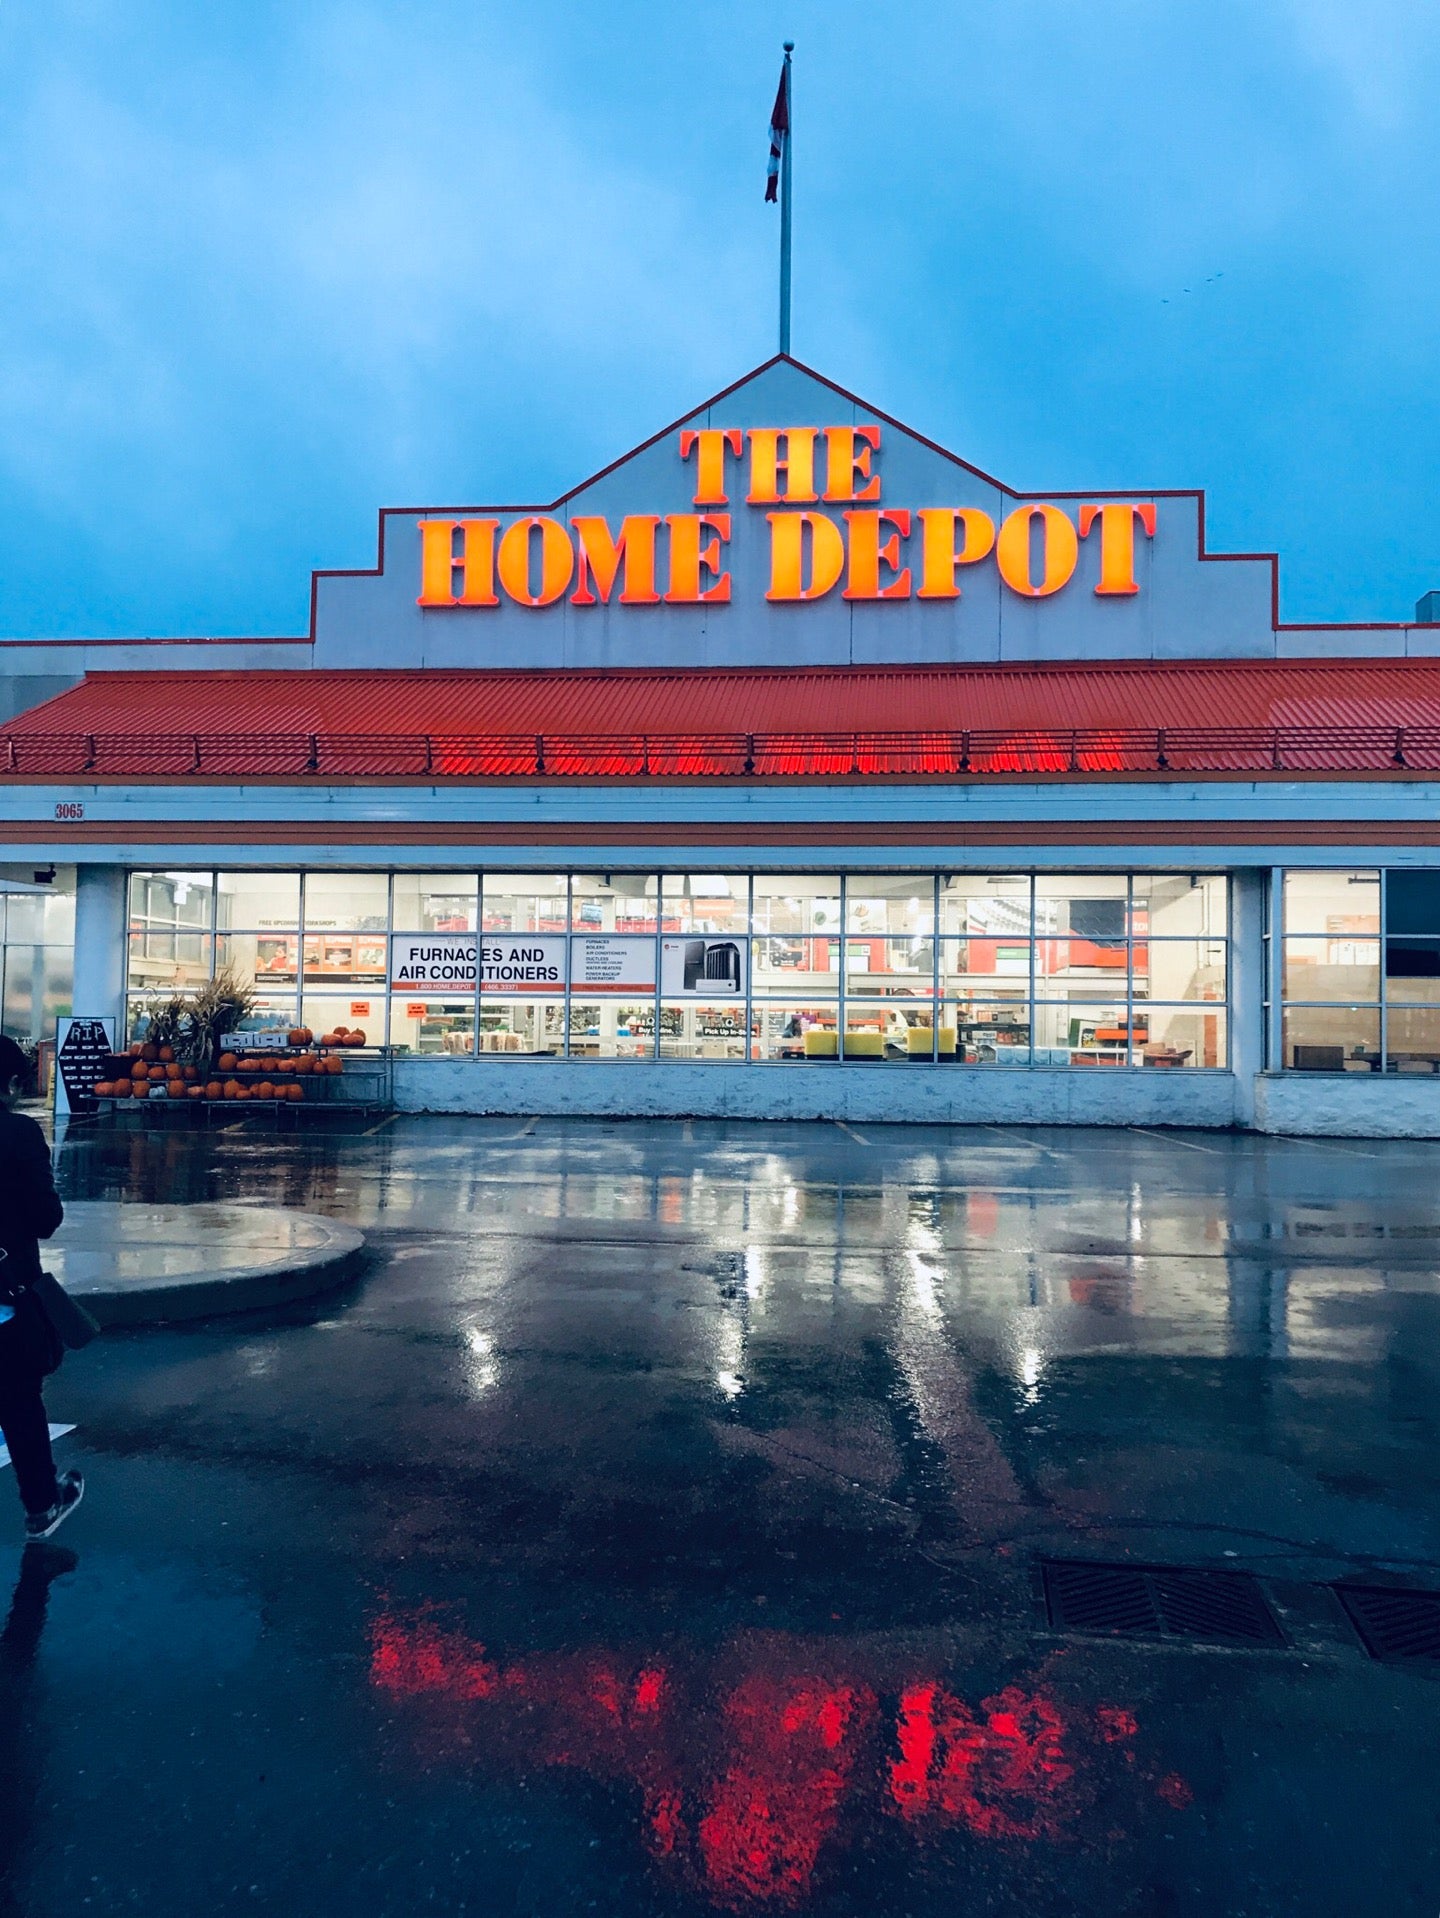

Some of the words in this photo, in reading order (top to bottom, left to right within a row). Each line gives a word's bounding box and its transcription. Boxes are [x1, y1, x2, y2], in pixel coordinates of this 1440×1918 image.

[680, 425, 882, 505] THE
[418, 512, 732, 607] HOME
[766, 502, 1156, 602] DEPOT
[56, 803, 83, 818] 3065
[464, 938, 501, 946] INSTALL
[409, 948, 503, 962] FURNACES
[509, 949, 545, 962] AND
[398, 966, 426, 979] AIR
[430, 966, 559, 980] CONDITIONERS
[70, 1026, 104, 1041] RIP
[638, 1026, 651, 1034] Buy
